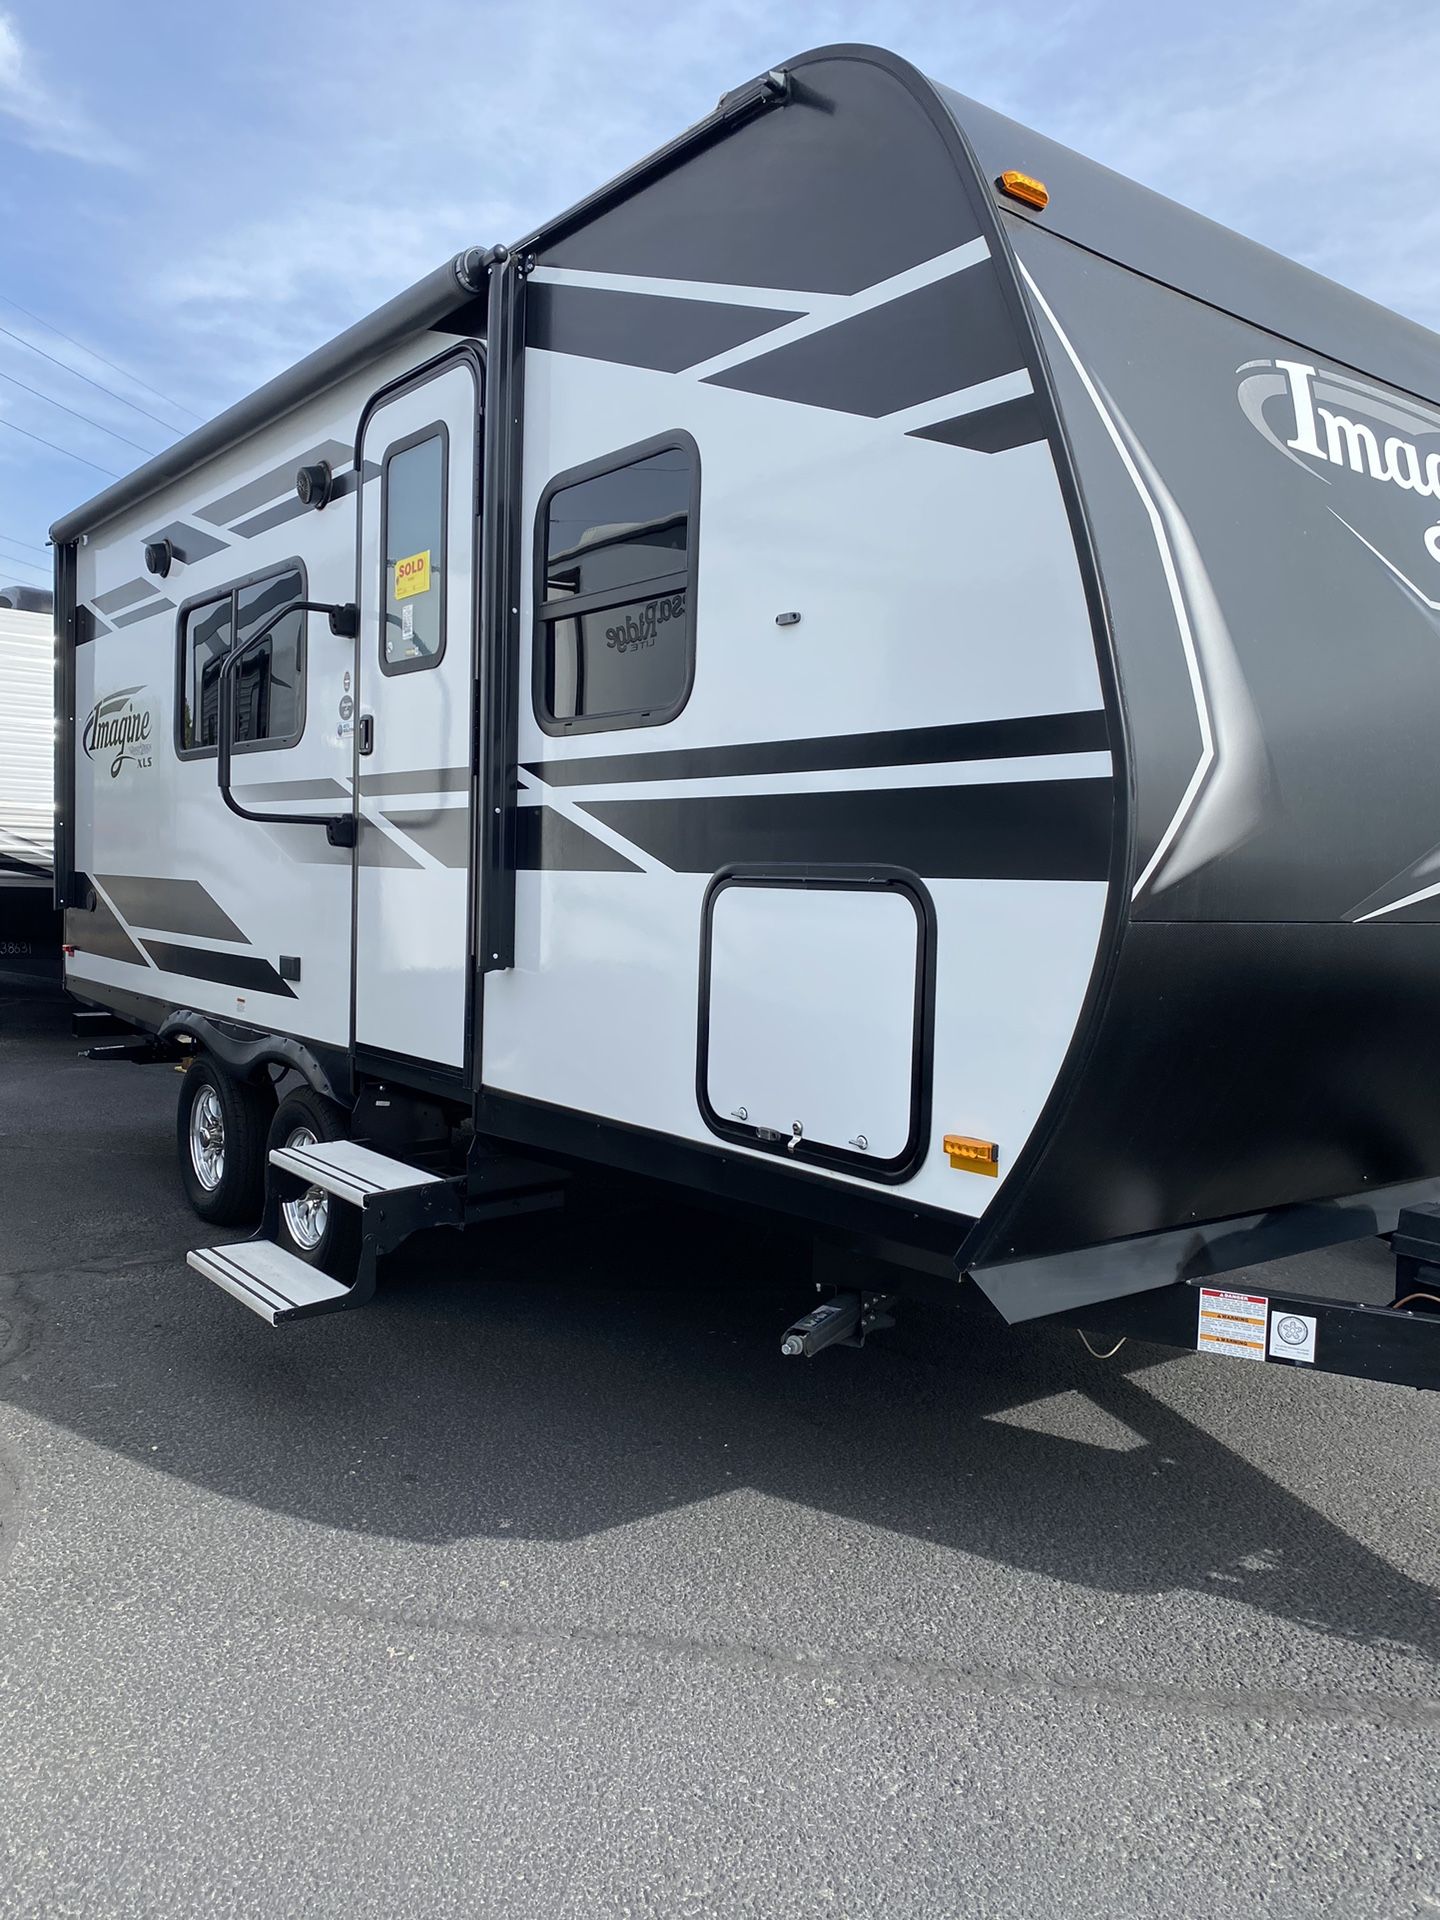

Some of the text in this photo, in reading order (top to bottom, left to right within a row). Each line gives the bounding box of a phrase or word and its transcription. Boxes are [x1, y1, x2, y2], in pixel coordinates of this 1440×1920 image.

[399, 558, 424, 578] SOLD
[88, 702, 152, 778] Imagine
[137, 757, 152, 768] XLS
